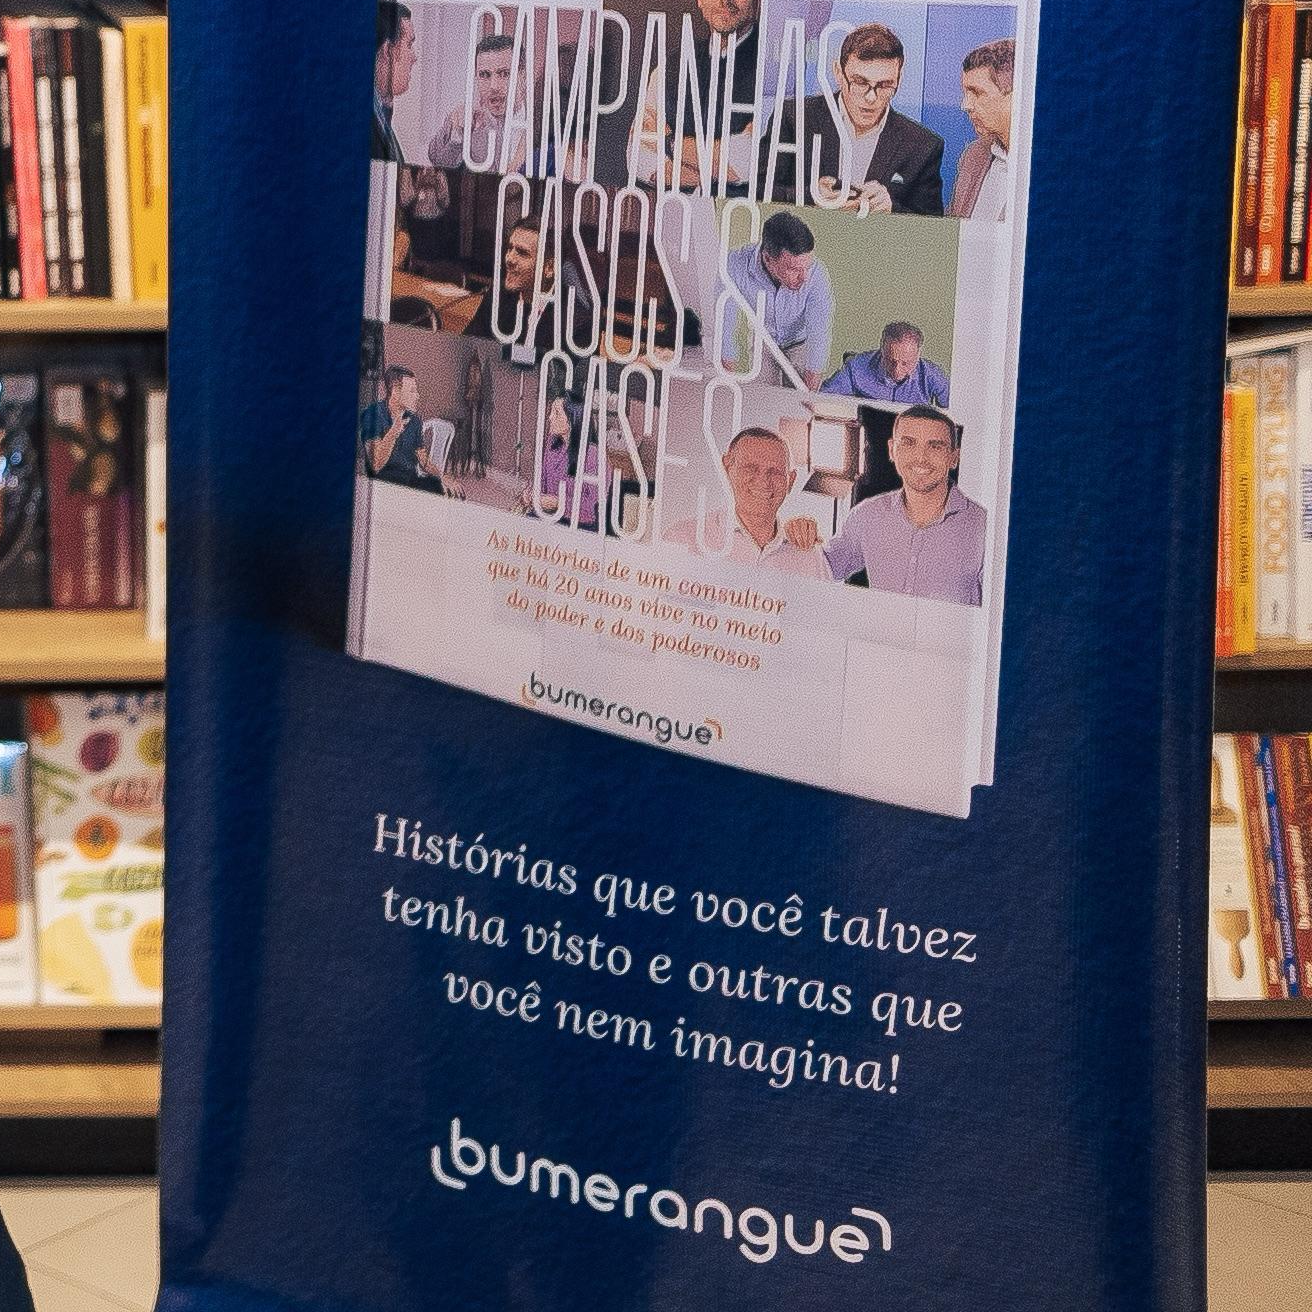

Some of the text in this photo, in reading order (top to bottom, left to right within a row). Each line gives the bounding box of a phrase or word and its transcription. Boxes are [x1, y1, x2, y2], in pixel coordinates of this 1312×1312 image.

[491, 174, 691, 370] CASOS
[486, 529, 787, 616] As histórias de um consultor
[486, 559, 783, 646] que há 20 anos vive no meio
[506, 588, 762, 672] do poder e dos poderosos
[530, 670, 713, 746] bumerangue
[374, 813, 978, 963] Histórias que você talvez
[382, 885, 964, 1036] tenha visto e outras que
[443, 969, 901, 1094] você nem imagina!
[448, 1117, 873, 1265] bumerangue
